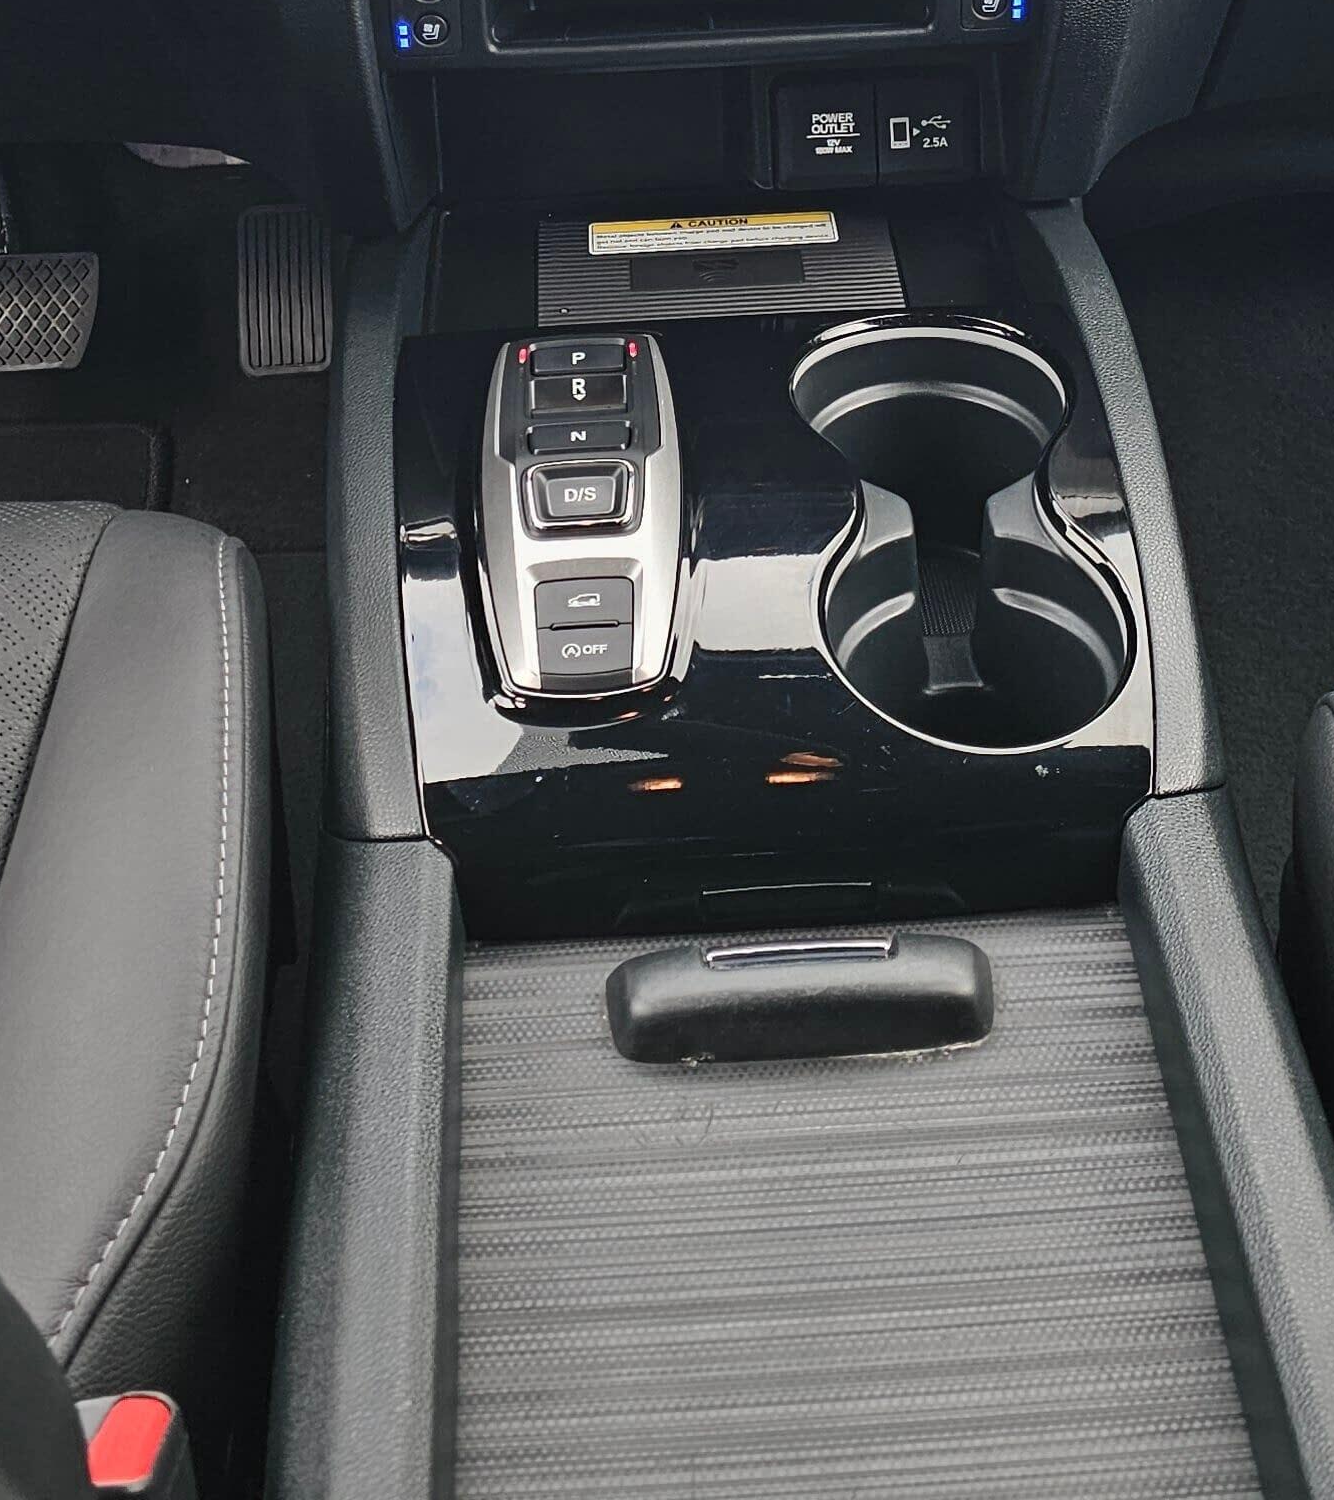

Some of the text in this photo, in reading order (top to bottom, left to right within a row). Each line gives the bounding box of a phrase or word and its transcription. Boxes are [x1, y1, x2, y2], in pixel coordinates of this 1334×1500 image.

[811, 112, 853, 124] POWER
[811, 122, 856, 134] OUTLET
[922, 136, 949, 149] 2.5A
[688, 217, 748, 228] CAUTION
[571, 352, 586, 365] P
[571, 378, 586, 395] R
[570, 430, 587, 442] N
[564, 486, 597, 503] D/S
[582, 643, 608, 655] OFF
